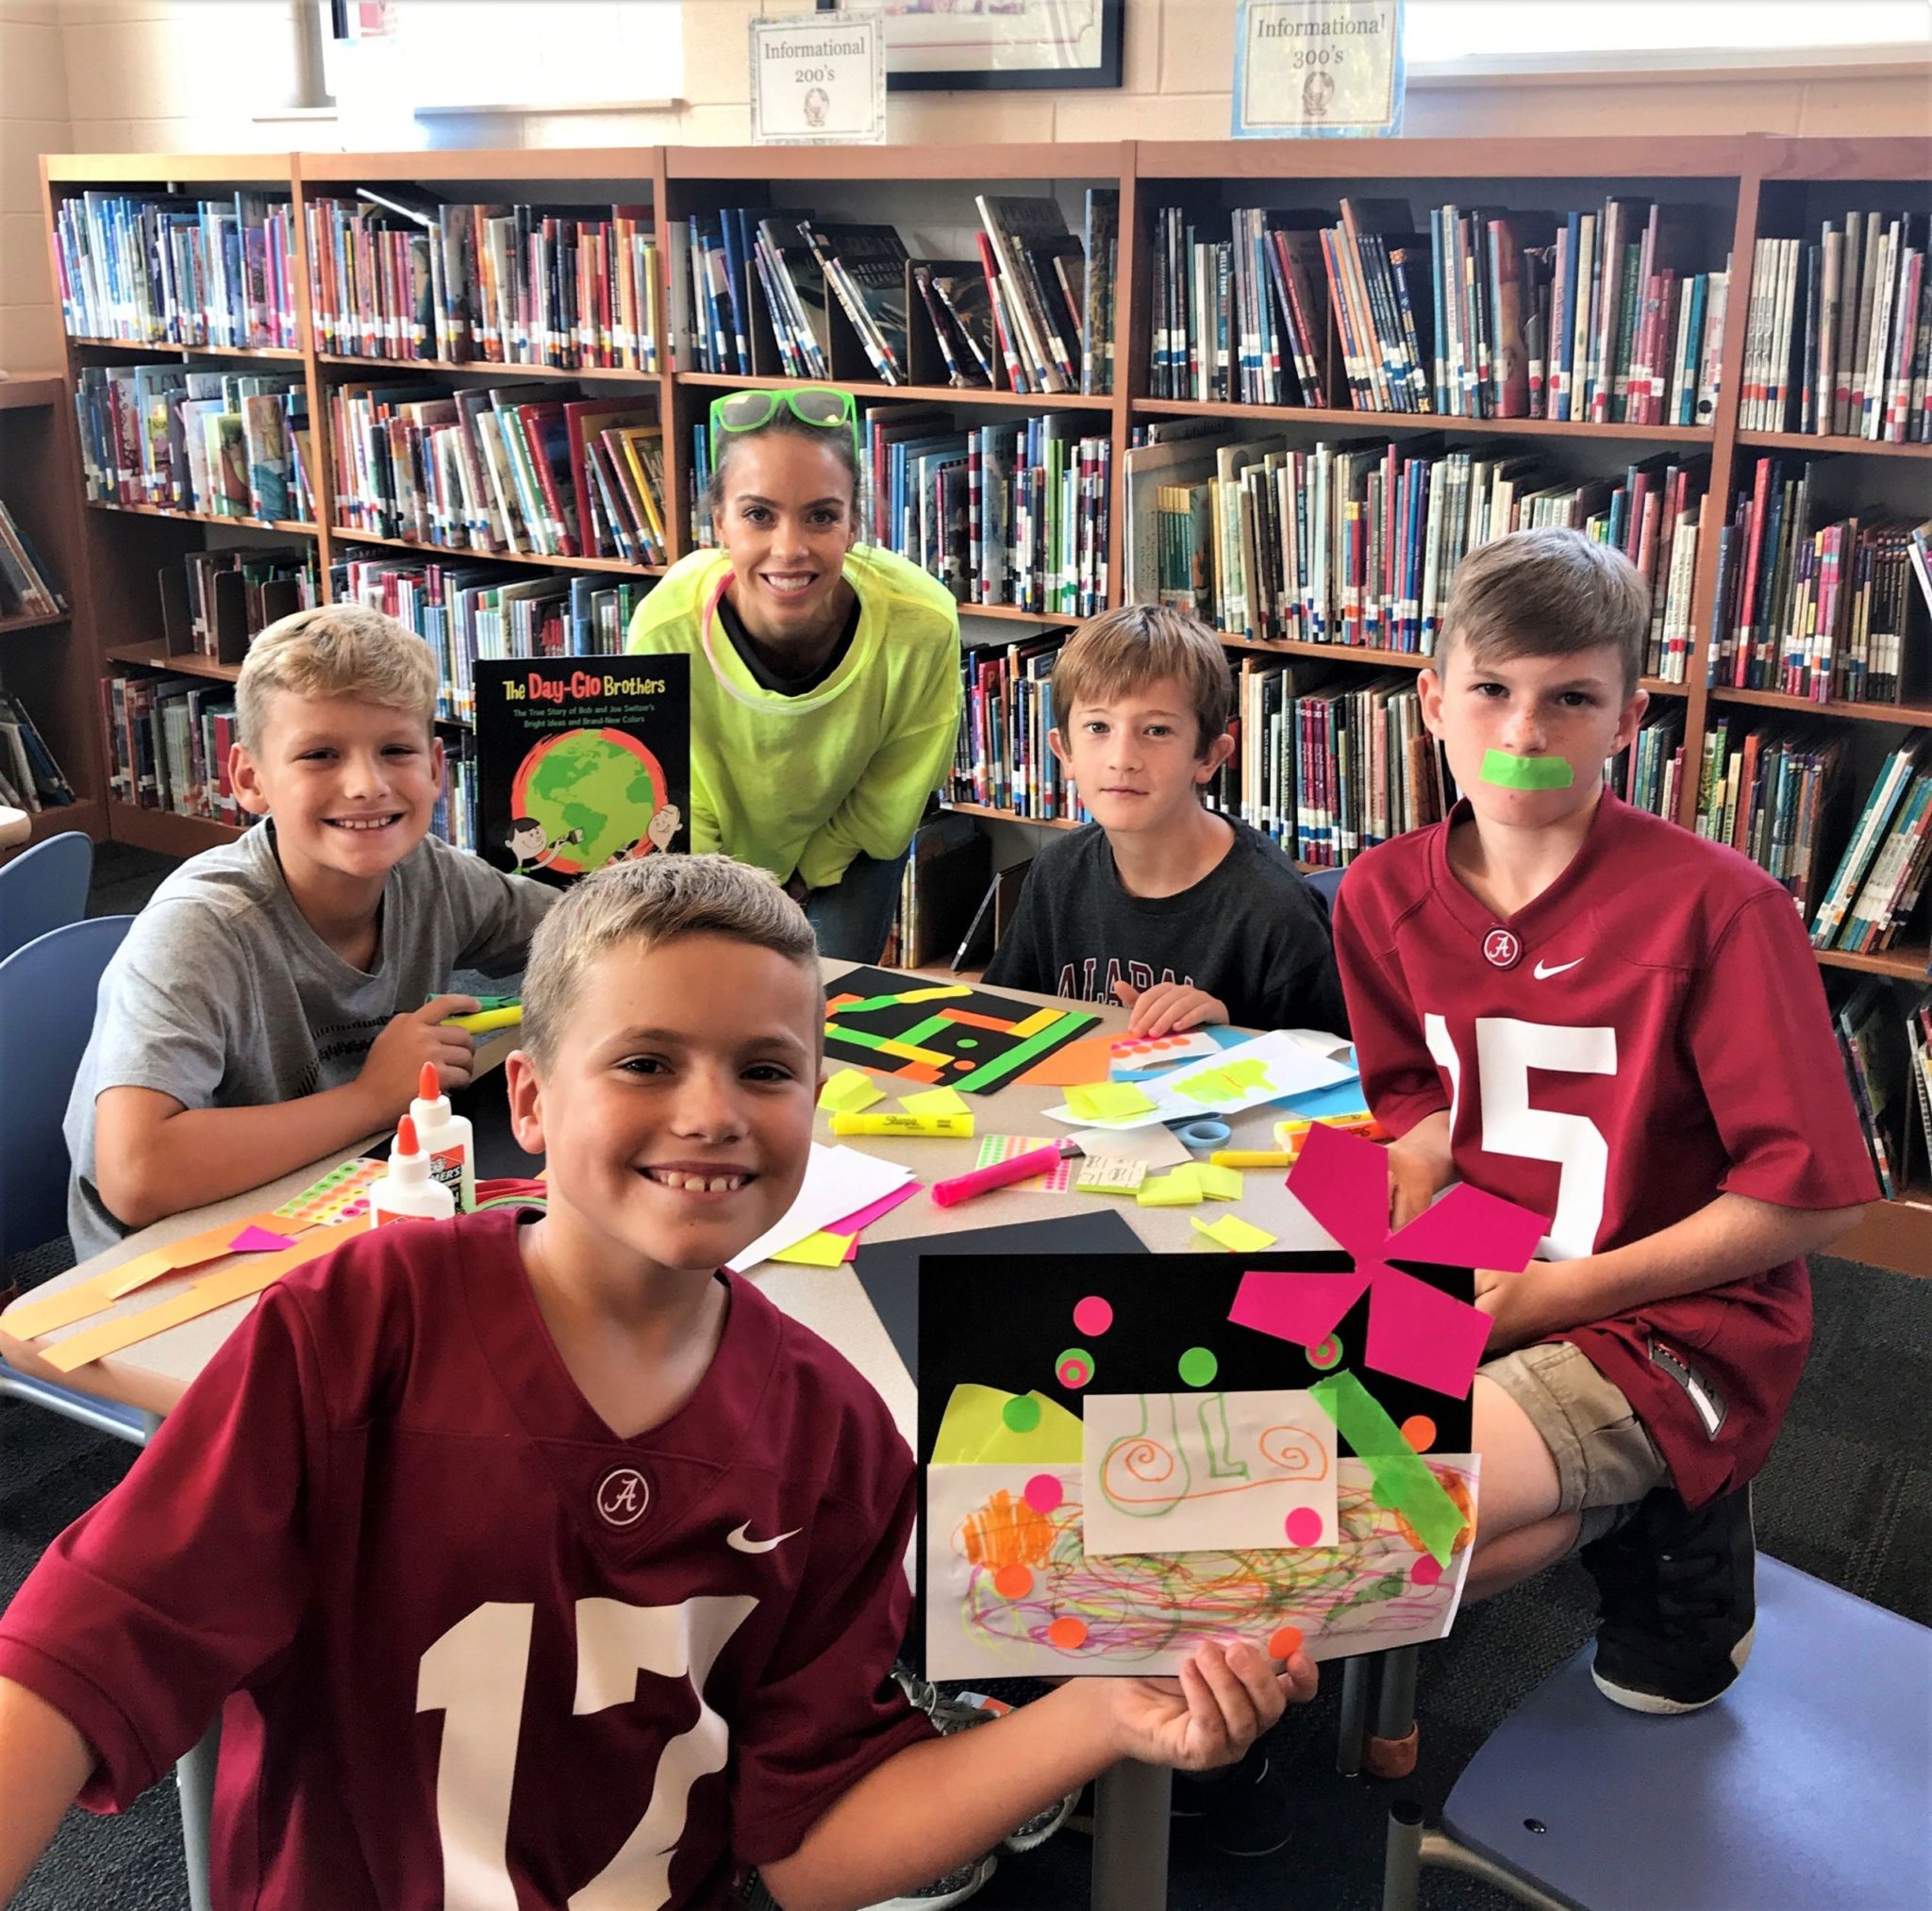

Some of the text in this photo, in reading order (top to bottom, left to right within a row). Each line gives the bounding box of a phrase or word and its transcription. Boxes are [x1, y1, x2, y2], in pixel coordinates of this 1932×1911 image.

[1257, 13, 1385, 38] Informational
[765, 37, 865, 59] Informational
[1293, 45, 1344, 69] 300's
[794, 64, 835, 83] 200's
[502, 671, 665, 703] The Day-Glo Brothers
[529, 708, 545, 717] True
[547, 707, 566, 717] Story
[524, 720, 545, 729] Bright
[415, 1595, 760, 1911] 17
